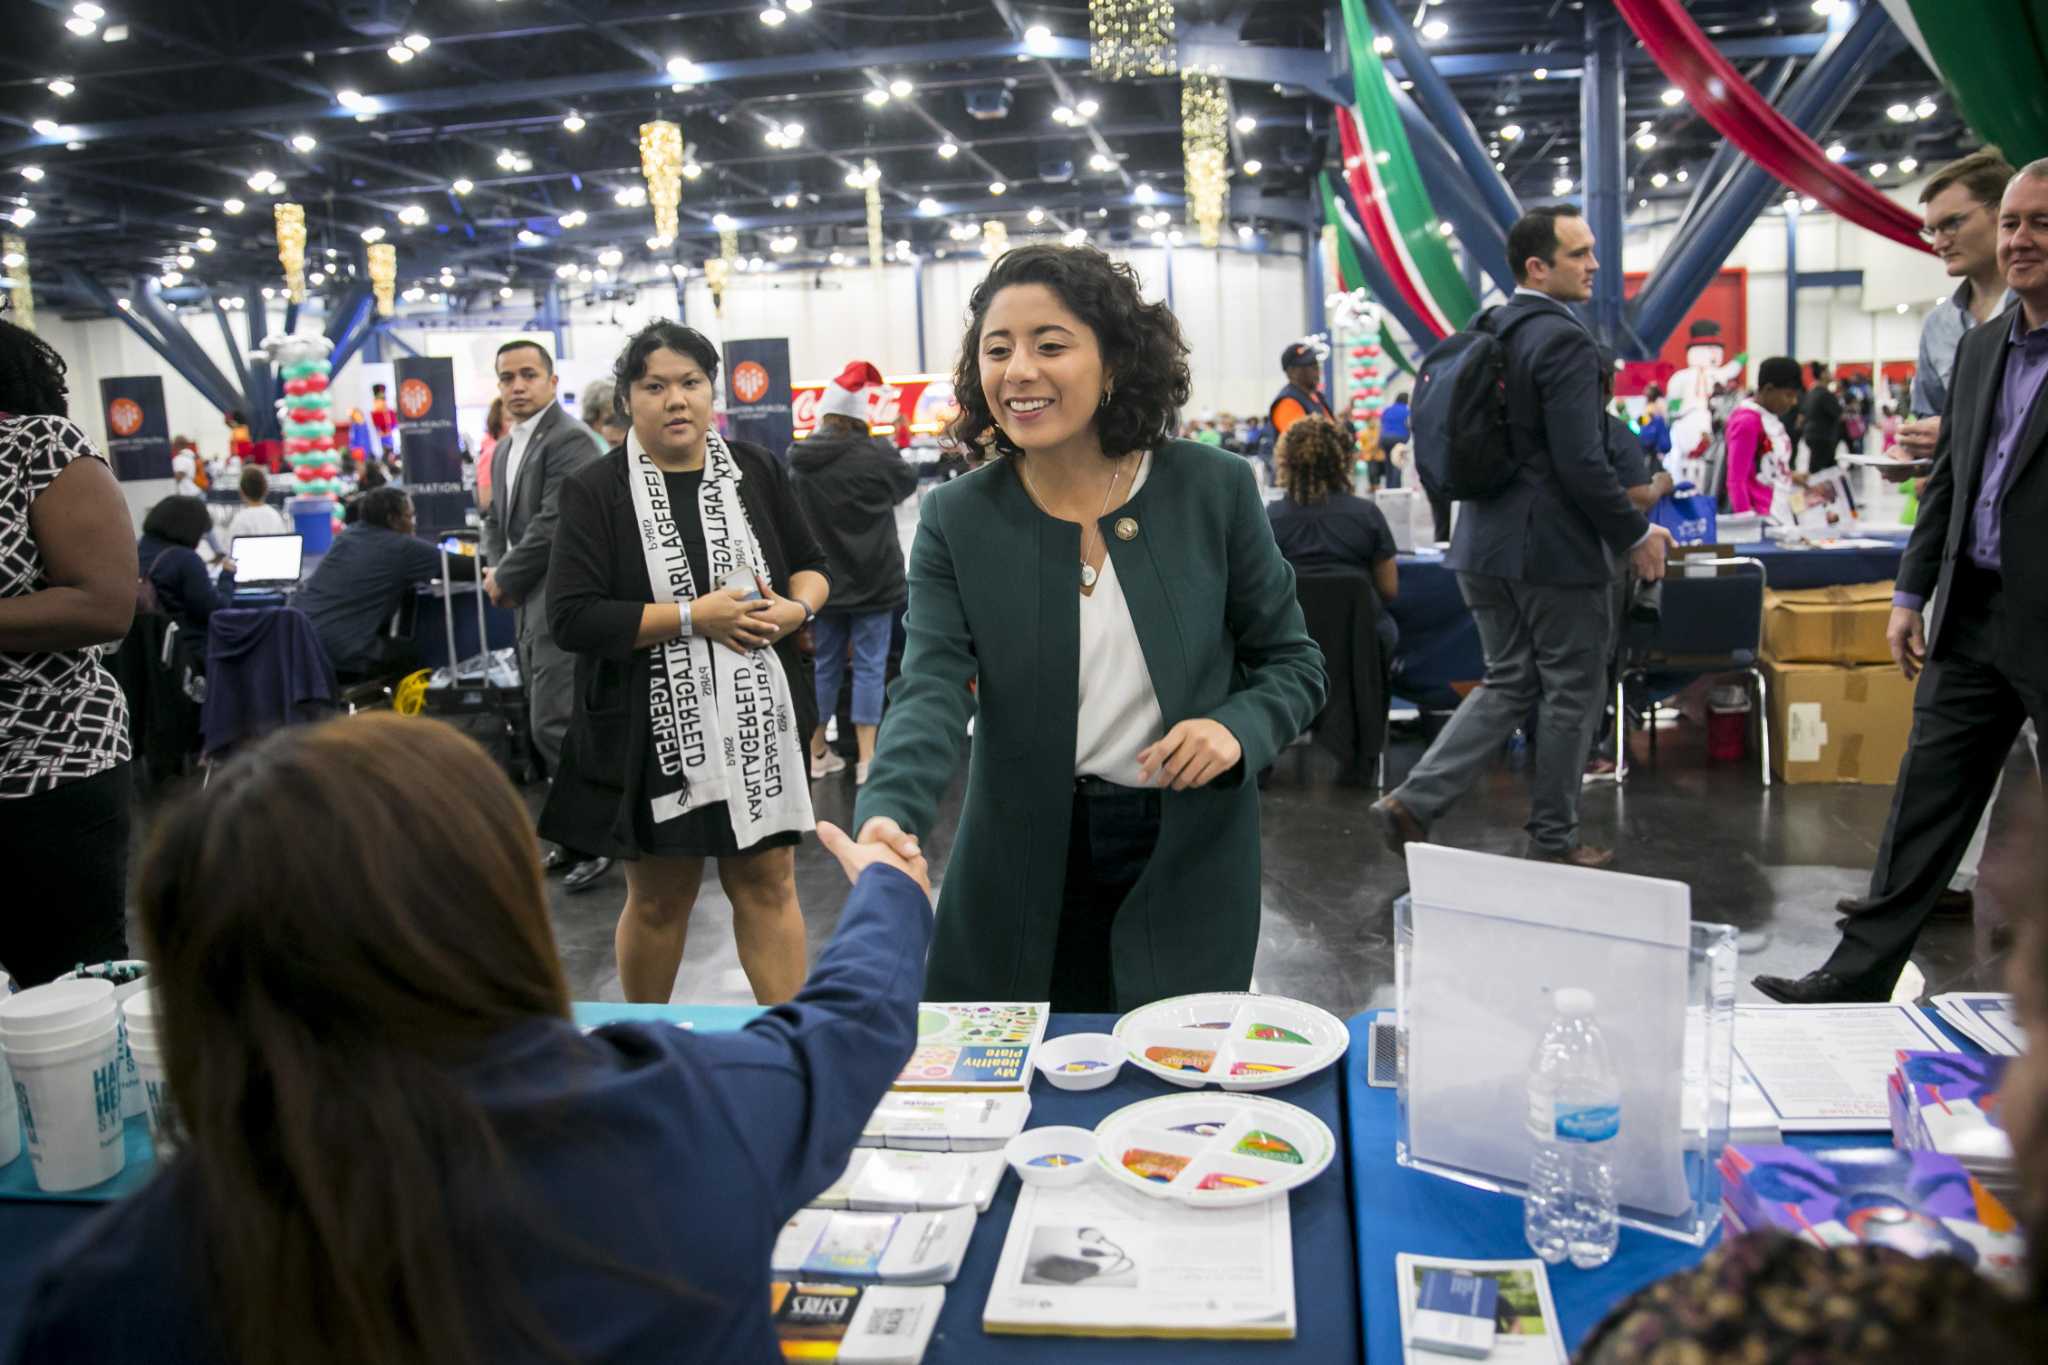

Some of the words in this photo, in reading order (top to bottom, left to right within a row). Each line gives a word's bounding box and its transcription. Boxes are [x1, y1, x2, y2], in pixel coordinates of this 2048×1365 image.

[985, 1049, 1023, 1058] Plate
[962, 1056, 1020, 1068] Healthy
[993, 1067, 1018, 1079] My
